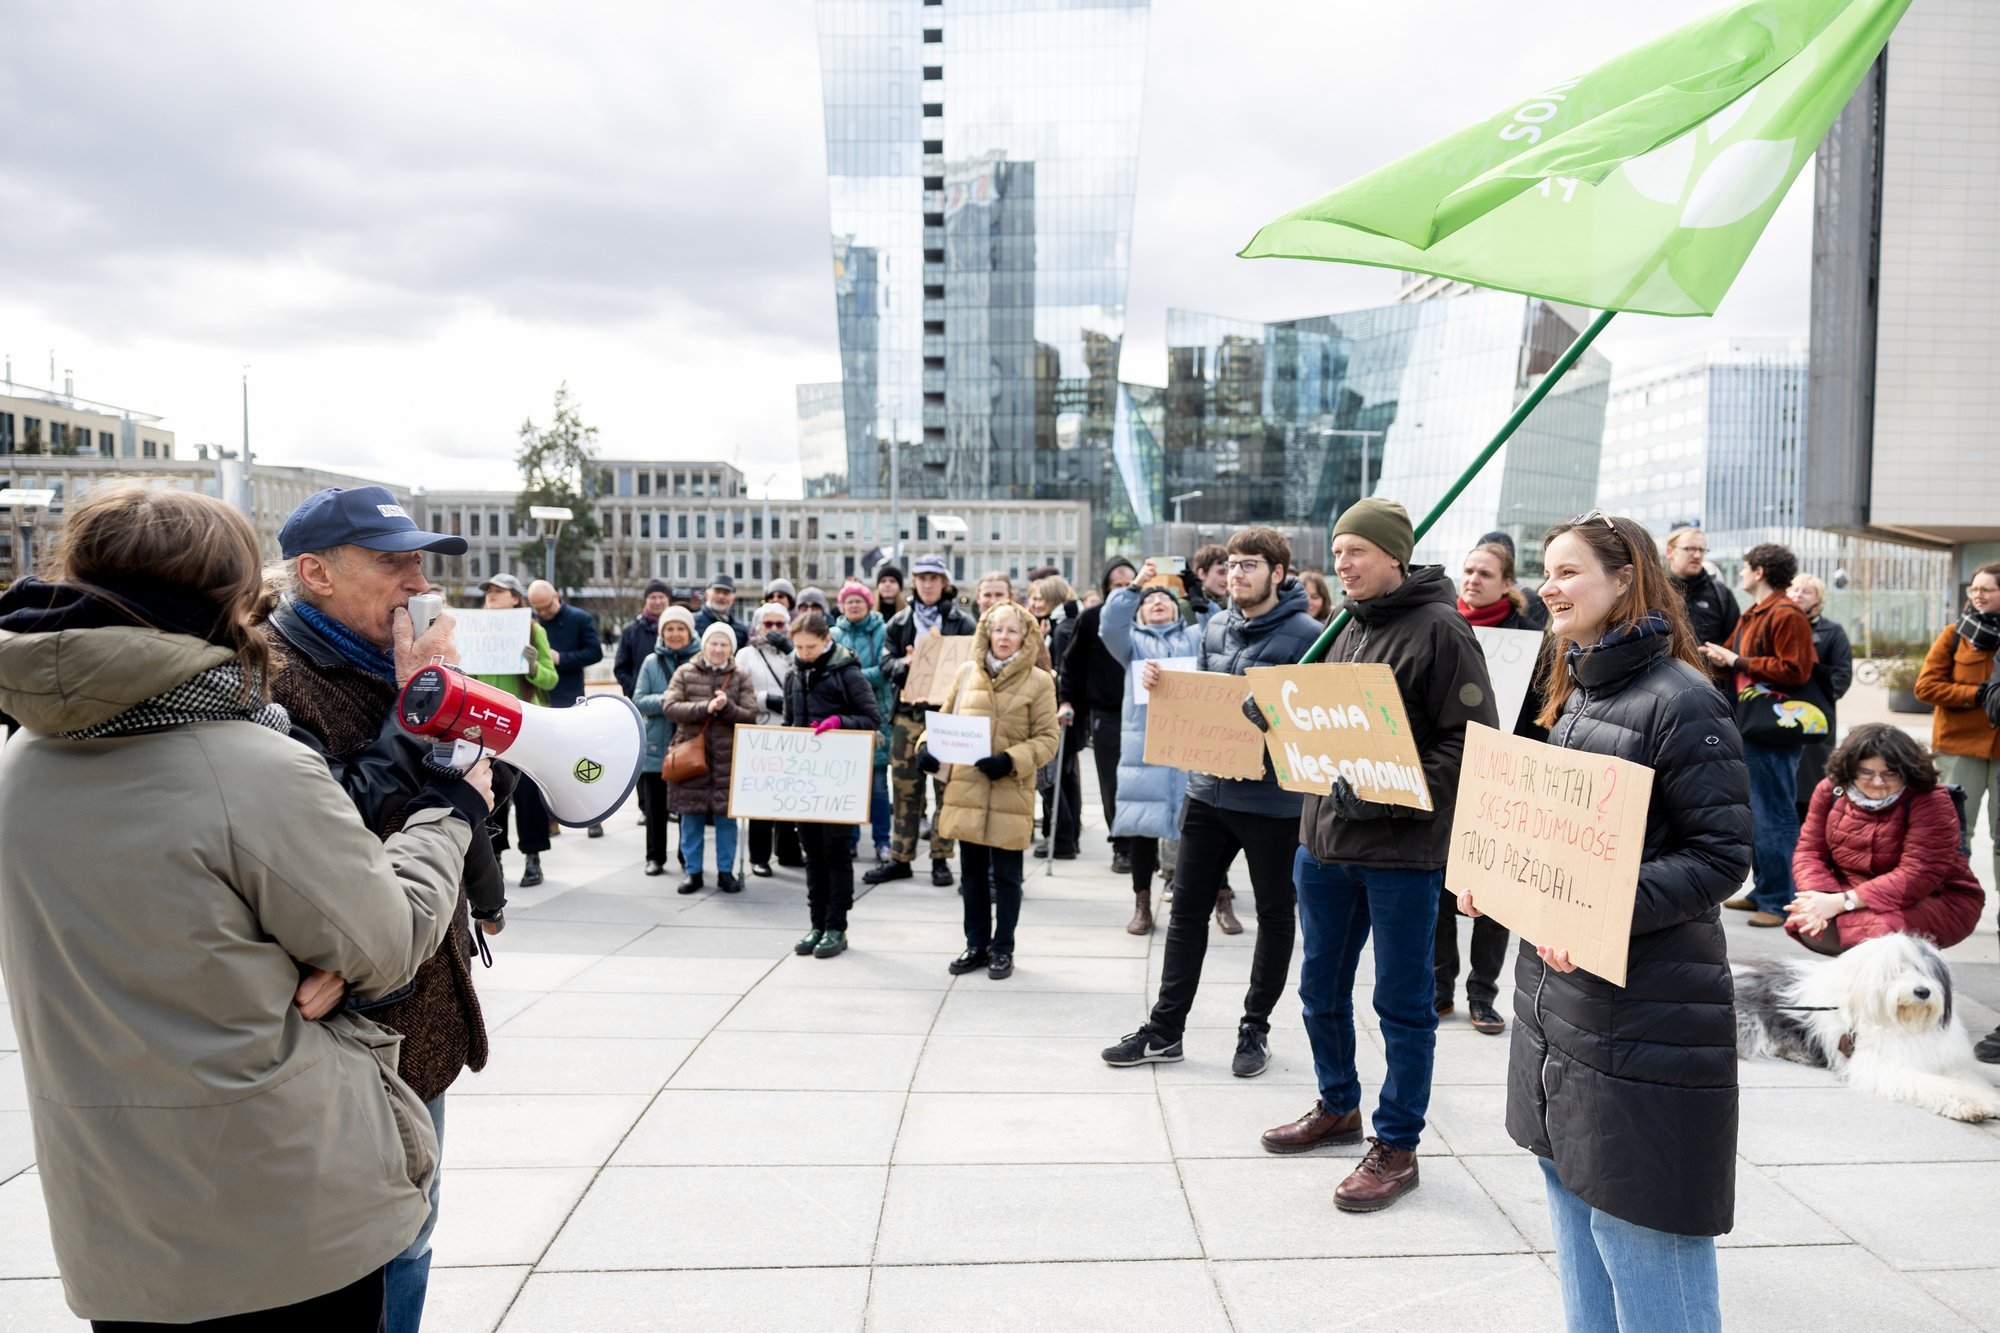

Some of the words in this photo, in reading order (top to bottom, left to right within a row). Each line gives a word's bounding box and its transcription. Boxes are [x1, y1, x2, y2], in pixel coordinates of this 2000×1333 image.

[747, 731, 822, 754] VILNIUS
[741, 776, 818, 794] EUROPOS
[1519, 755, 1537, 796] AR
[1542, 762, 1593, 810] MATAI
[1462, 831, 1496, 871] TAVO
[1533, 808, 1619, 861] DŪMUOSE
